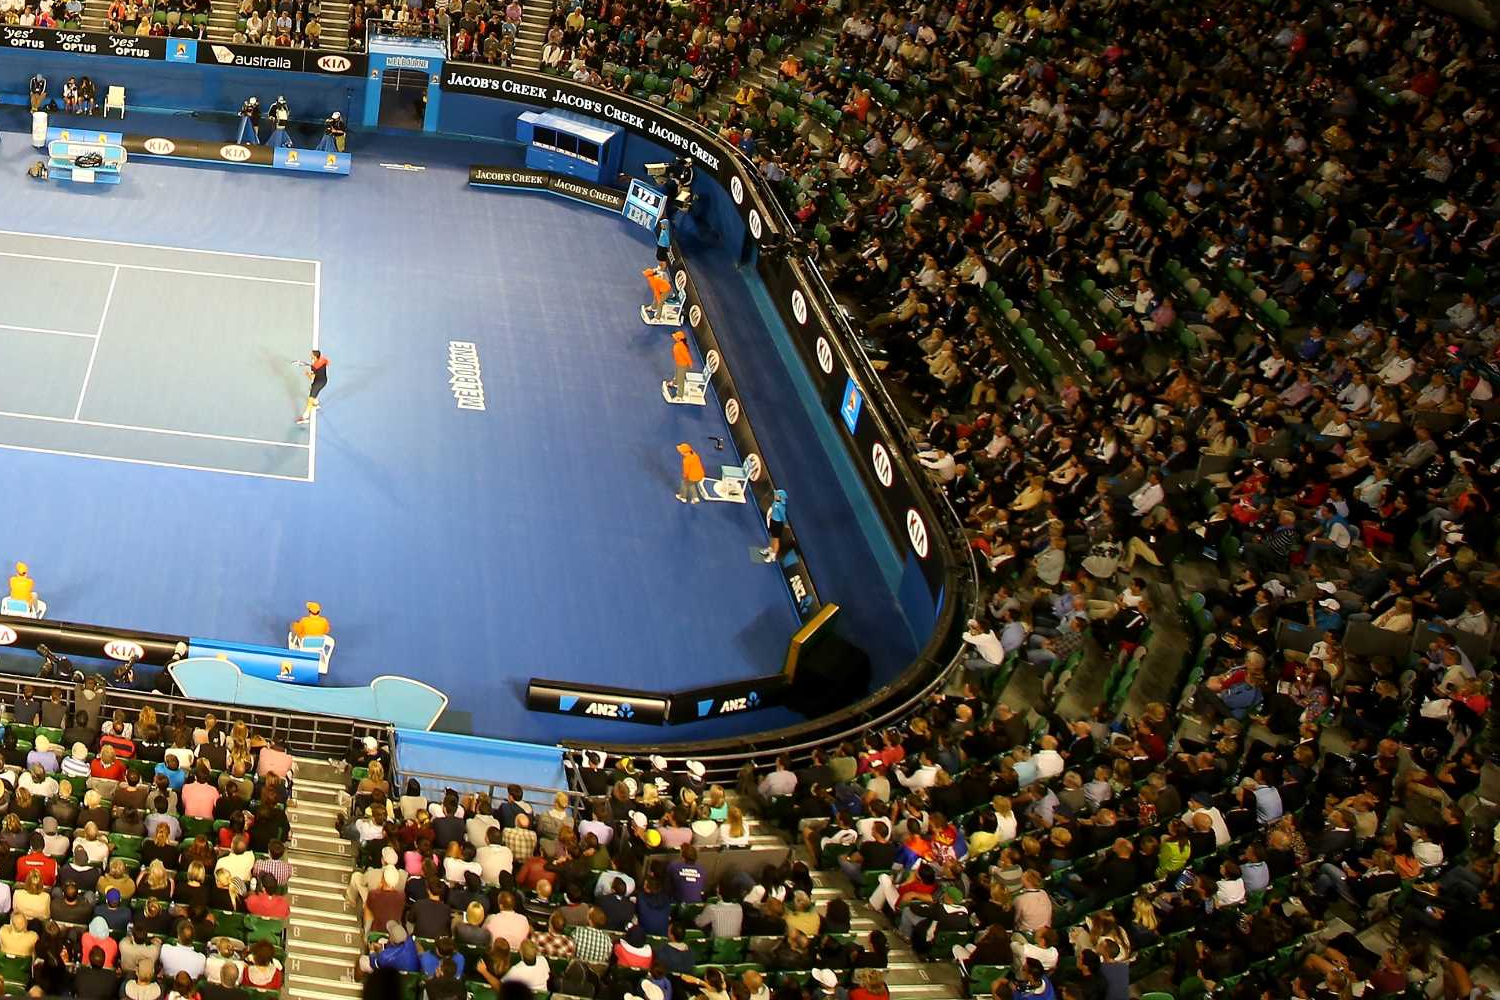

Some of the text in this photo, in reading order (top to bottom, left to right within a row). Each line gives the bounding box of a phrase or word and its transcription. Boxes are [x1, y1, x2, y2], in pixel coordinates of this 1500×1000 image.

[10, 38, 44, 49] OPTUS
[62, 42, 97, 53] OPTUS
[115, 47, 149, 58] OPTUS
[235, 54, 291, 69] australia
[323, 58, 345, 69] KIA
[448, 73, 547, 99] JACOB'S CREEK
[552, 89, 645, 129] JACOB'S CREEK
[149, 141, 171, 153] KIA
[225, 146, 246, 158] KIA
[648, 120, 720, 171] JACOB'S CREEK
[475, 169, 543, 185] JACOB'S CREEK
[553, 178, 620, 205] JACOB'S CREEK
[626, 206, 653, 232] IBM
[793, 292, 805, 322] KIA
[818, 339, 832, 372] KIA
[448, 341, 485, 410] MELBOURNE
[874, 446, 890, 485] KIA
[909, 512, 927, 555] KIA
[790, 575, 807, 603] ANZ
[585, 702, 618, 718] ANZ
[720, 698, 747, 713] ANZ
[291, 960, 300, 971] H
